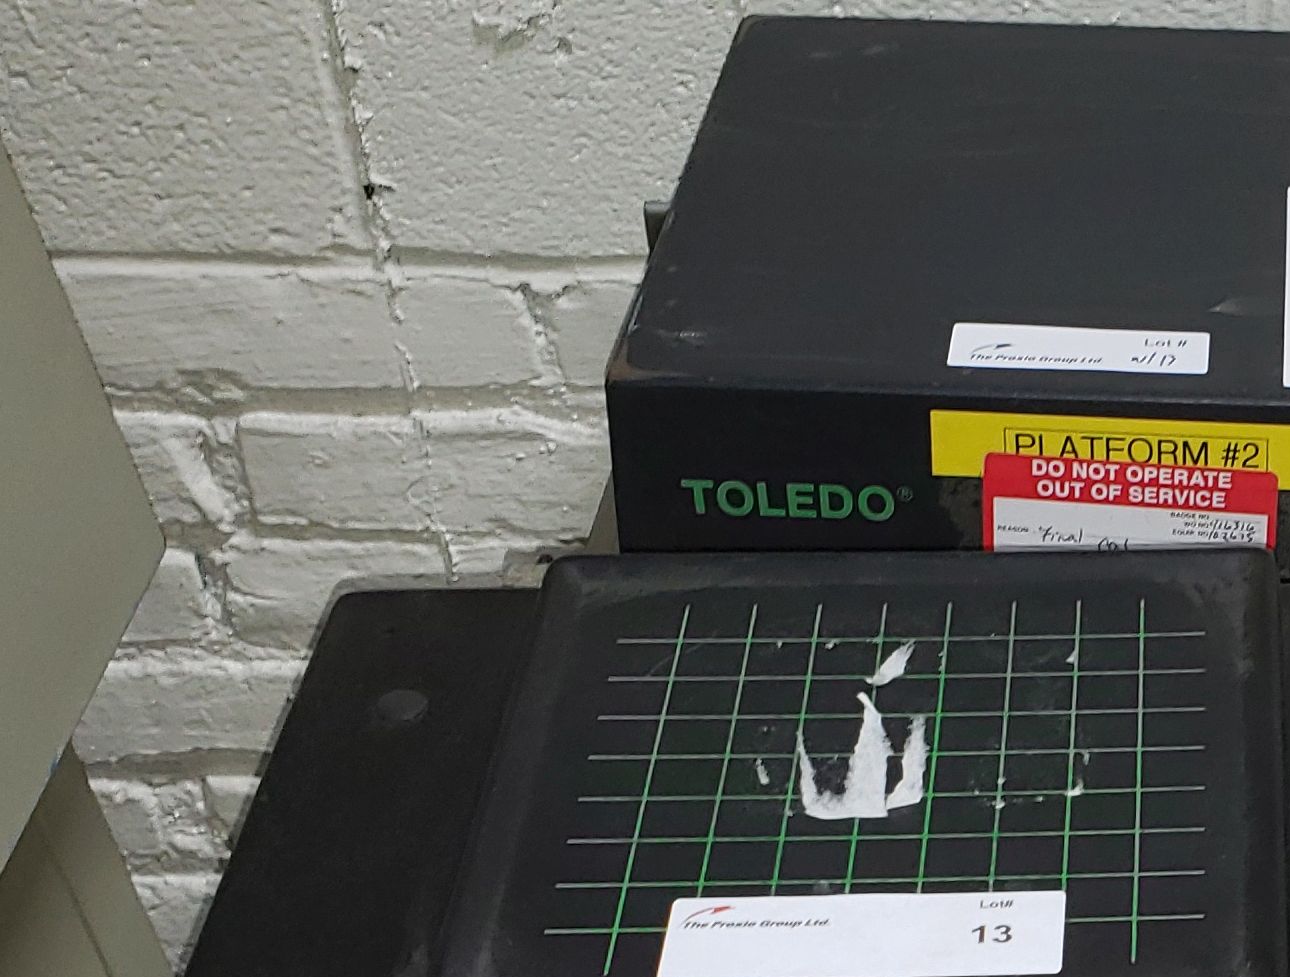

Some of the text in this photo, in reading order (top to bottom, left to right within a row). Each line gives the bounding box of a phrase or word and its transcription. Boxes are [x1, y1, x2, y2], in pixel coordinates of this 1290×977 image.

[1221, 441, 1260, 468] #2
[1031, 459, 1232, 490] DO NOT OPERATE
[680, 478, 895, 522] TOLEDO
[1036, 478, 1226, 509] OUT OF SERVICE
[971, 924, 1014, 944] 13
